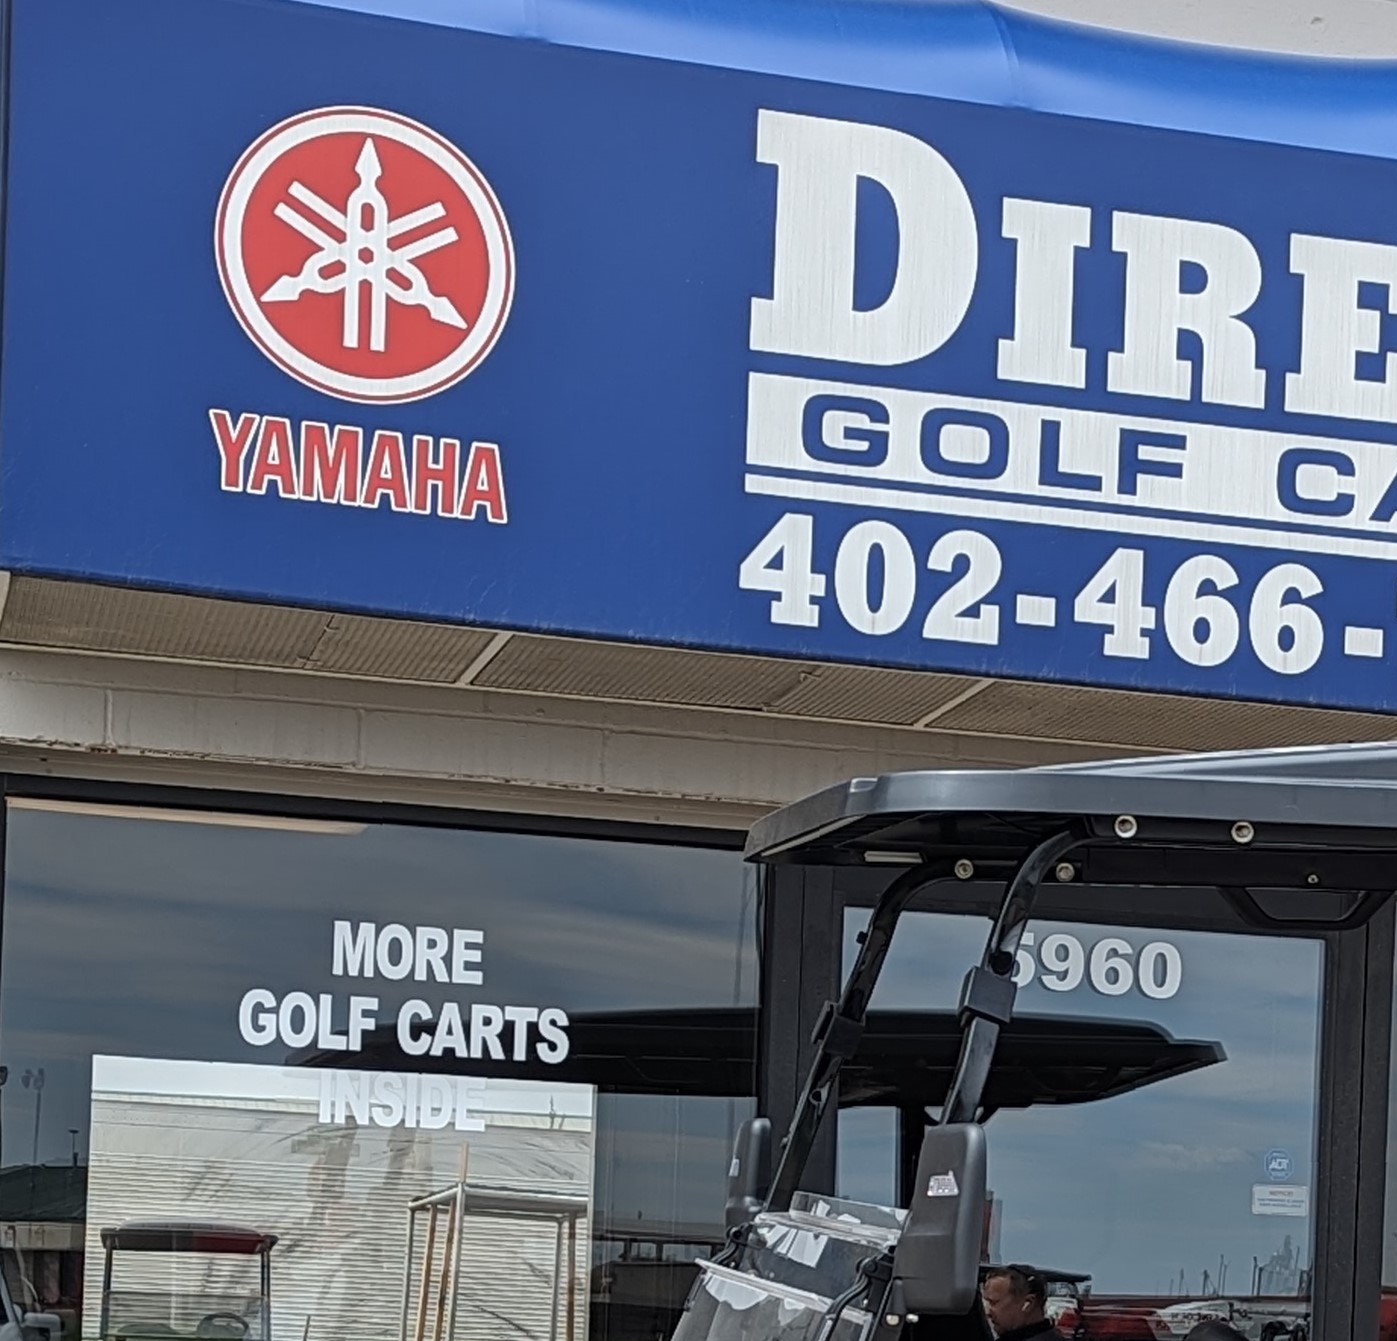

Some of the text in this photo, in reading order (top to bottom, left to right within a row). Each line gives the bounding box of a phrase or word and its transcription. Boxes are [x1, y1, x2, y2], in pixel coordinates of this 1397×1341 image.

[208, 409, 508, 525] YAMAHA
[802, 393, 1188, 497] GOLF
[331, 919, 484, 986] MORE
[239, 990, 571, 1065] GOLF CARTS
[317, 1071, 487, 1133] INSIDE
